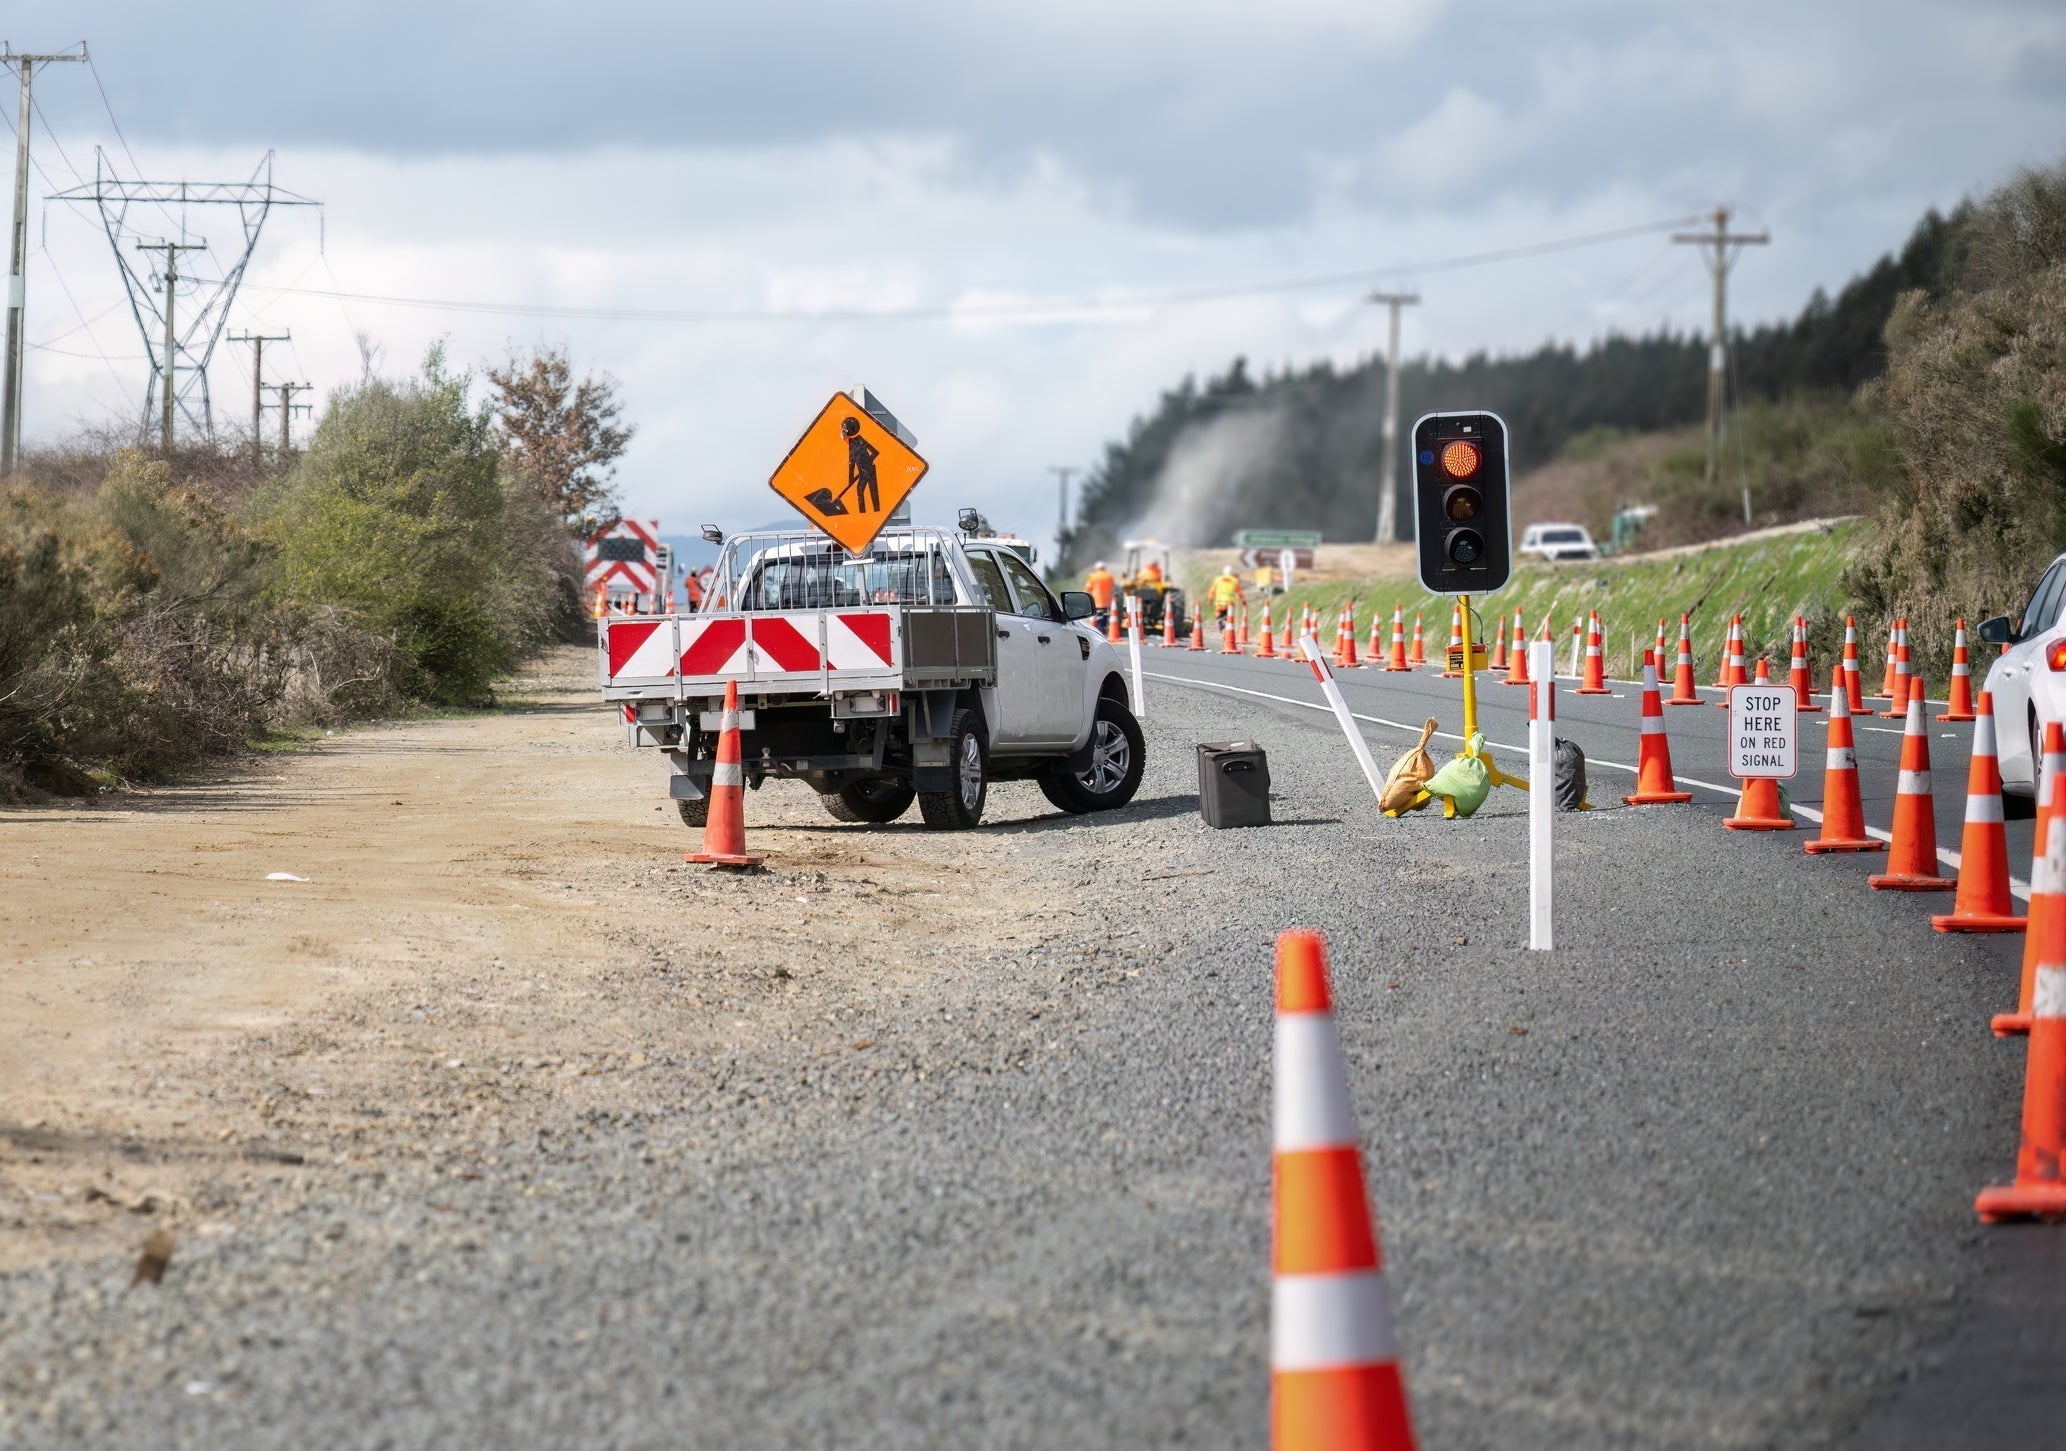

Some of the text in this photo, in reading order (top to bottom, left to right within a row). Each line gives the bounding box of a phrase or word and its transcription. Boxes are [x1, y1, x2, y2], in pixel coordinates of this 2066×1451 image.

[1746, 697, 1781, 711] STOP
[1744, 717, 1782, 731] HERE
[1740, 737, 1786, 749] ON RED
[1742, 755, 1784, 767] SIGNAL
